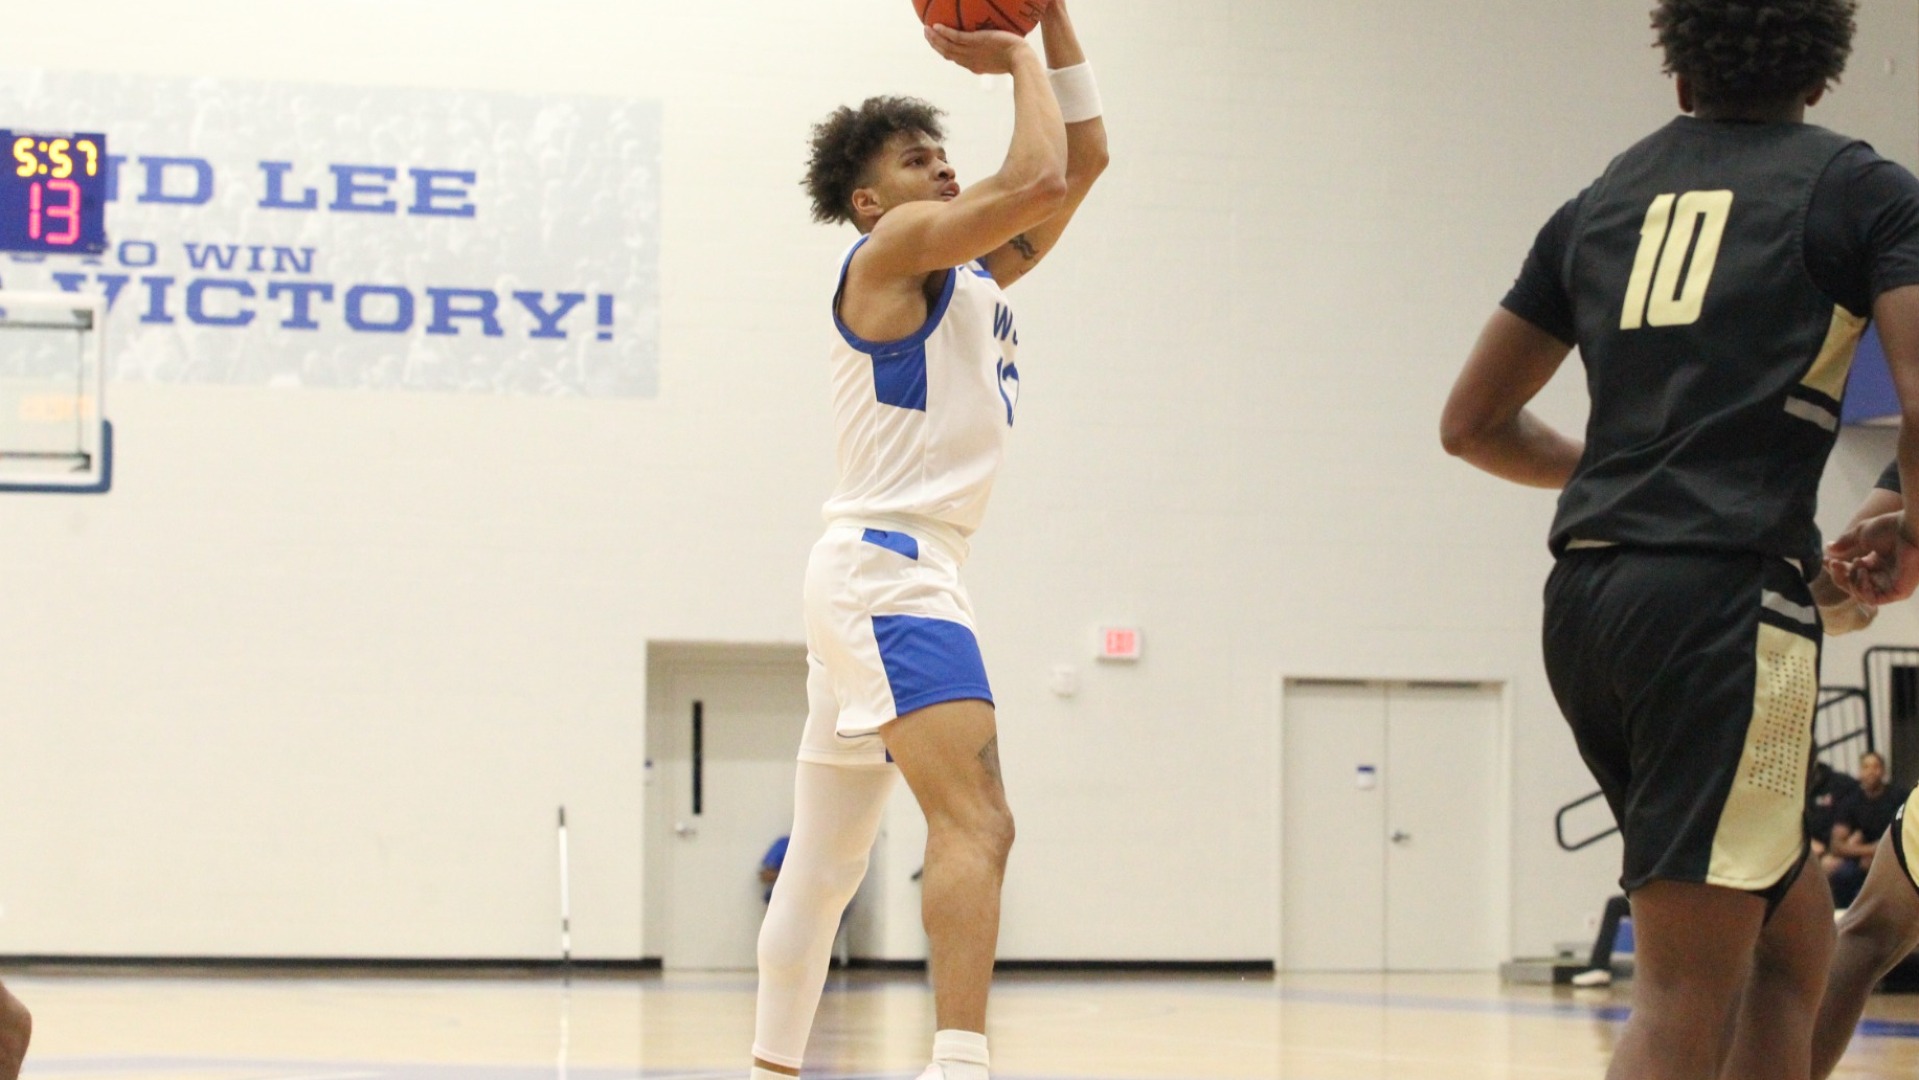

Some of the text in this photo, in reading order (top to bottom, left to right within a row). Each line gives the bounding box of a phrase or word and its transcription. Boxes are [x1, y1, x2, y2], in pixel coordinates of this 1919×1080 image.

[13, 137, 98, 178] 5:57
[28, 179, 81, 244] 13
[258, 161, 477, 218] LEE
[183, 243, 317, 273] WIN
[1619, 189, 1734, 330] 10
